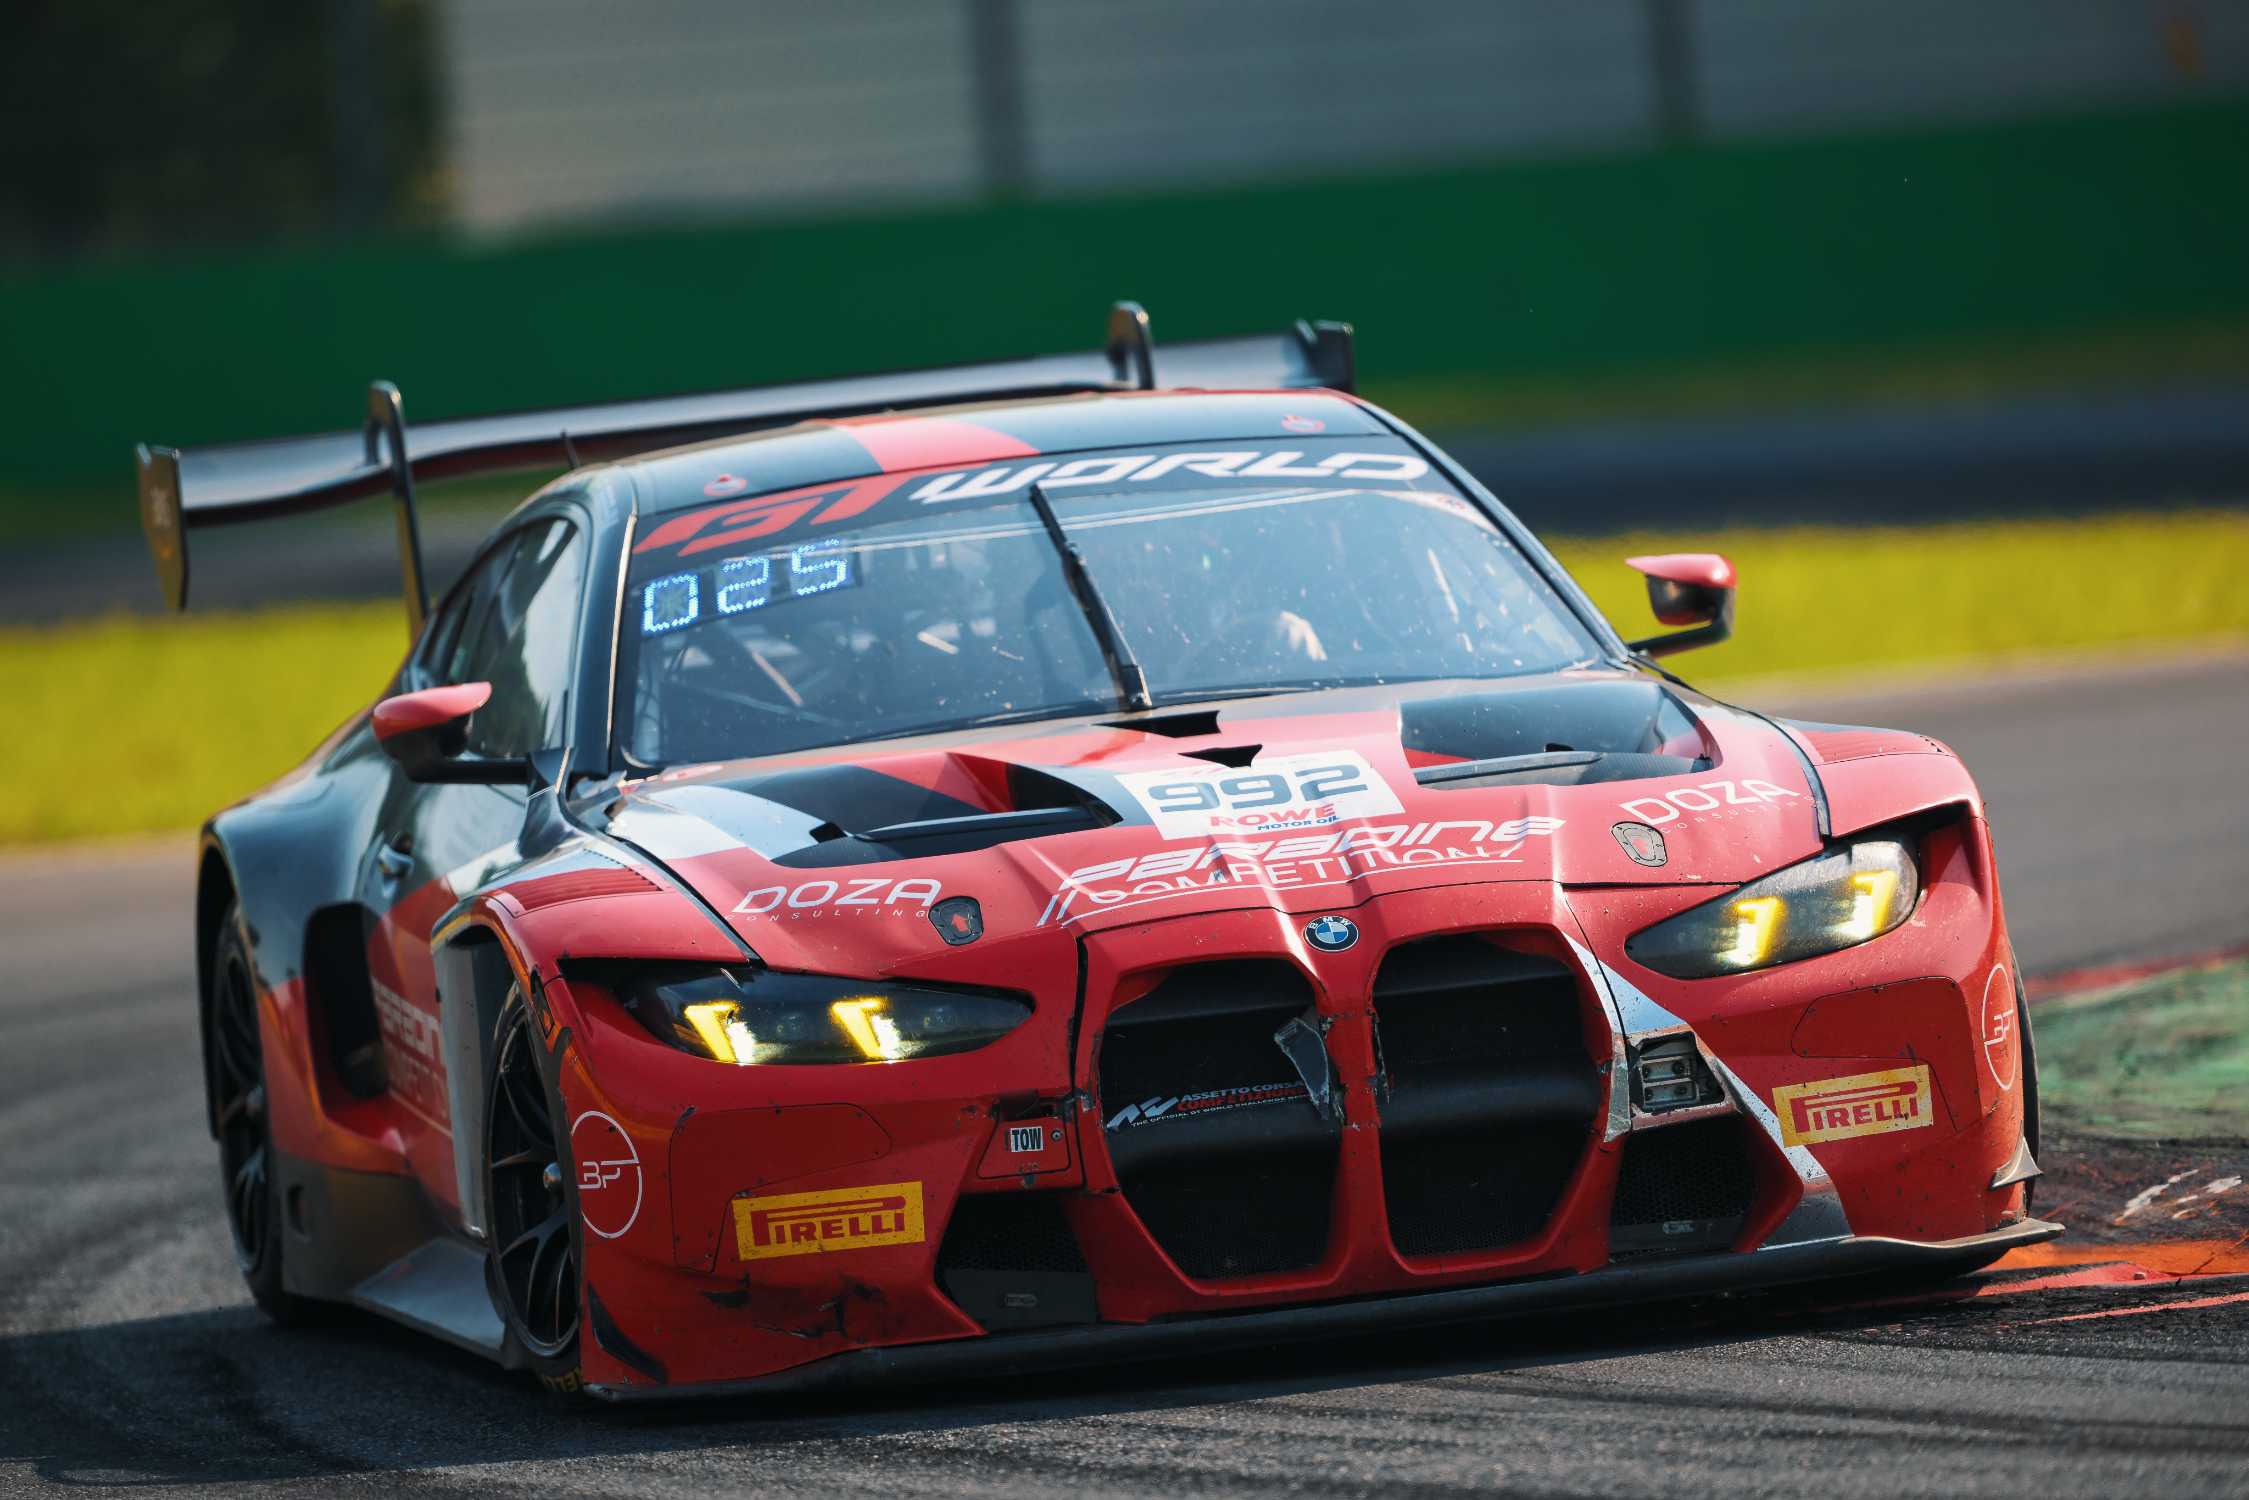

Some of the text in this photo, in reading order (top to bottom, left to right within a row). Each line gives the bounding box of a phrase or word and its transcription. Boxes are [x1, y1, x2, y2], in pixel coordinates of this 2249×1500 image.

[631, 451, 1430, 557] GT WORLD
[643, 538, 847, 633] 025
[1147, 764, 1368, 813] 992
[1619, 779, 1800, 825] DOZA
[1210, 803, 1336, 827] ROWE
[1257, 815, 1340, 831] MOTOR OIL
[731, 878, 942, 913] DOZA
[725, 907, 928, 922] CONSULTING
[1308, 915, 1351, 930] BMW
[1180, 1087, 1250, 1103] ASSETTO
[1790, 1080, 1919, 1134] PIRELLI
[1011, 1127, 1042, 1151] TOW
[751, 1195, 906, 1247] PIRELLI
